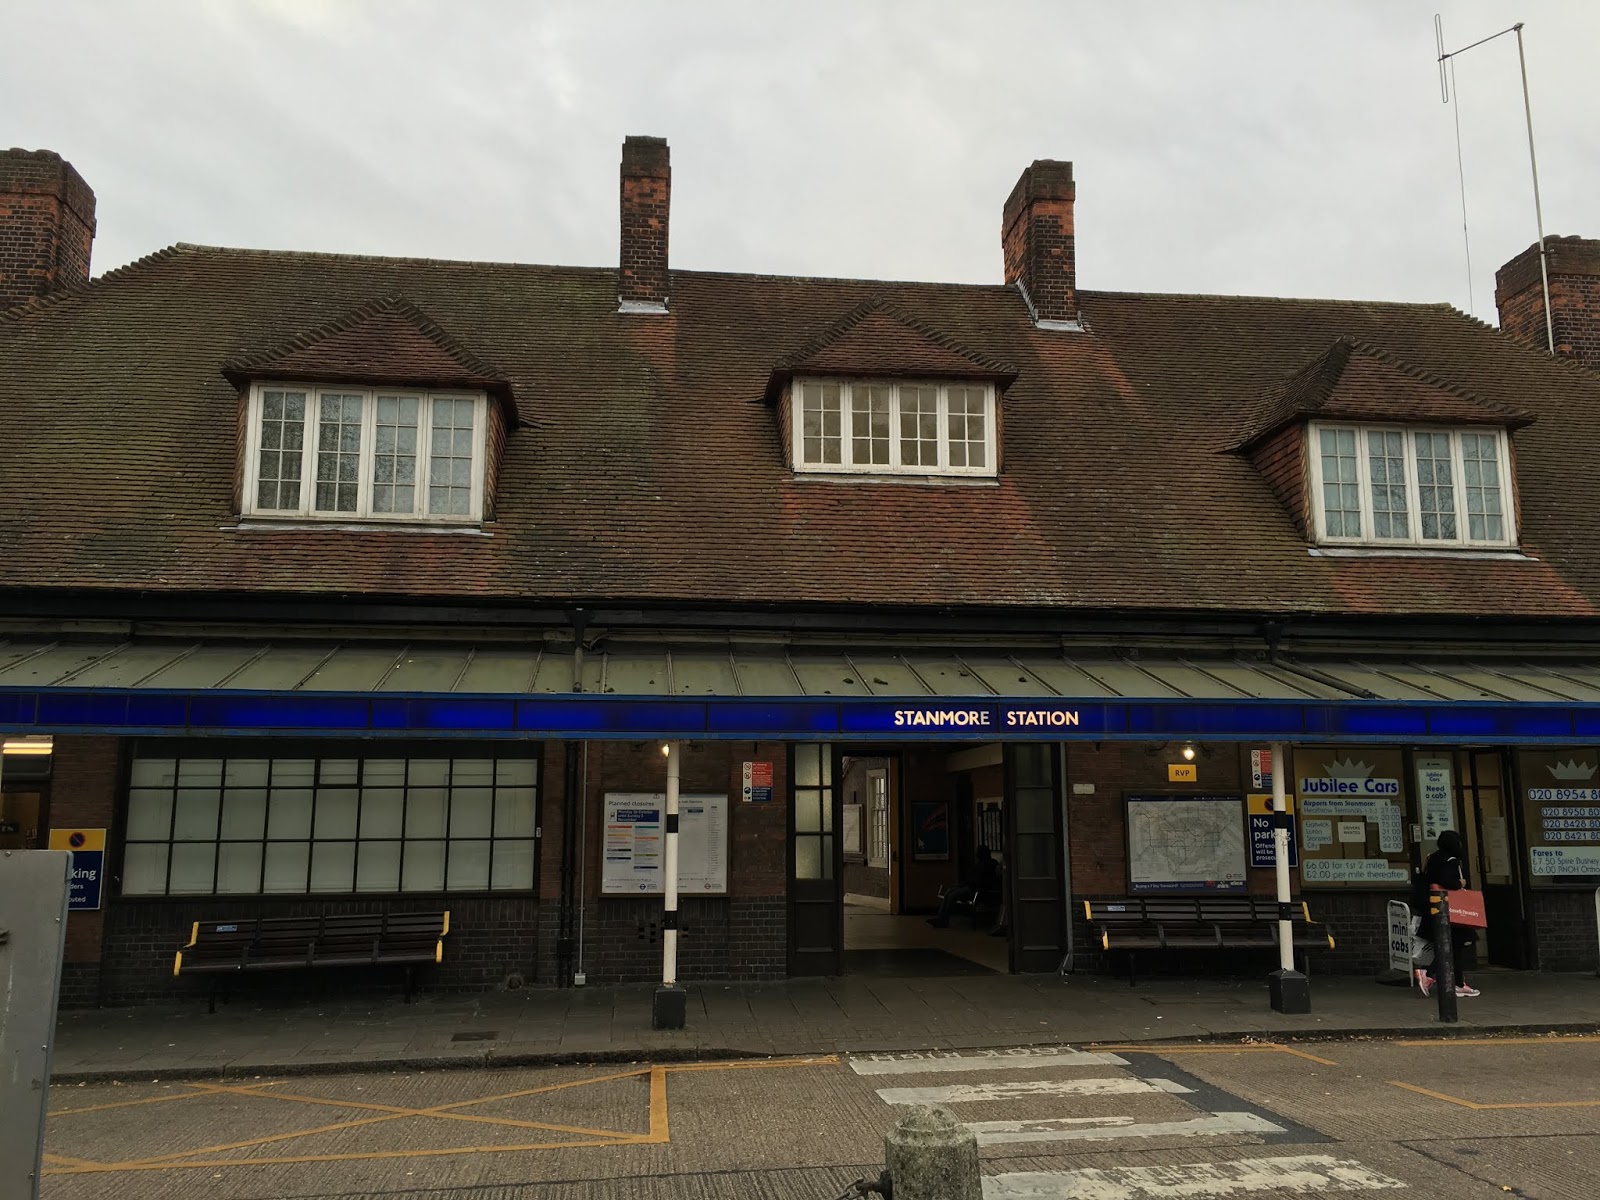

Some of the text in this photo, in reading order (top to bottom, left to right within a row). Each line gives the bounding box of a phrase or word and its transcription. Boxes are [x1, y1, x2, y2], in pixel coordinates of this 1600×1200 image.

[894, 710, 1080, 726] STANMORE STATION
[1175, 769, 1190, 777] RVP
[1303, 779, 1398, 793] Jubilee Cars
[1529, 789, 1600, 800] 020 8954 8
[1542, 808, 1559, 816] 020
[1562, 808, 1585, 816] 8950
[1254, 818, 1269, 828] No
[1543, 819, 1560, 828] 020
[1563, 819, 1586, 828] 8428
[1255, 829, 1291, 842] parkg
[1544, 831, 1561, 840] 020
[1564, 831, 1586, 840] 8421
[1358, 861, 1364, 869] 2
[1576, 857, 1599, 866] Bushey
[1332, 872, 1345, 880] per
[1348, 870, 1365, 878] mile
[1367, 870, 1404, 878] thereafter
[1392, 921, 1409, 936] mini
[1391, 938, 1409, 953] cabs
